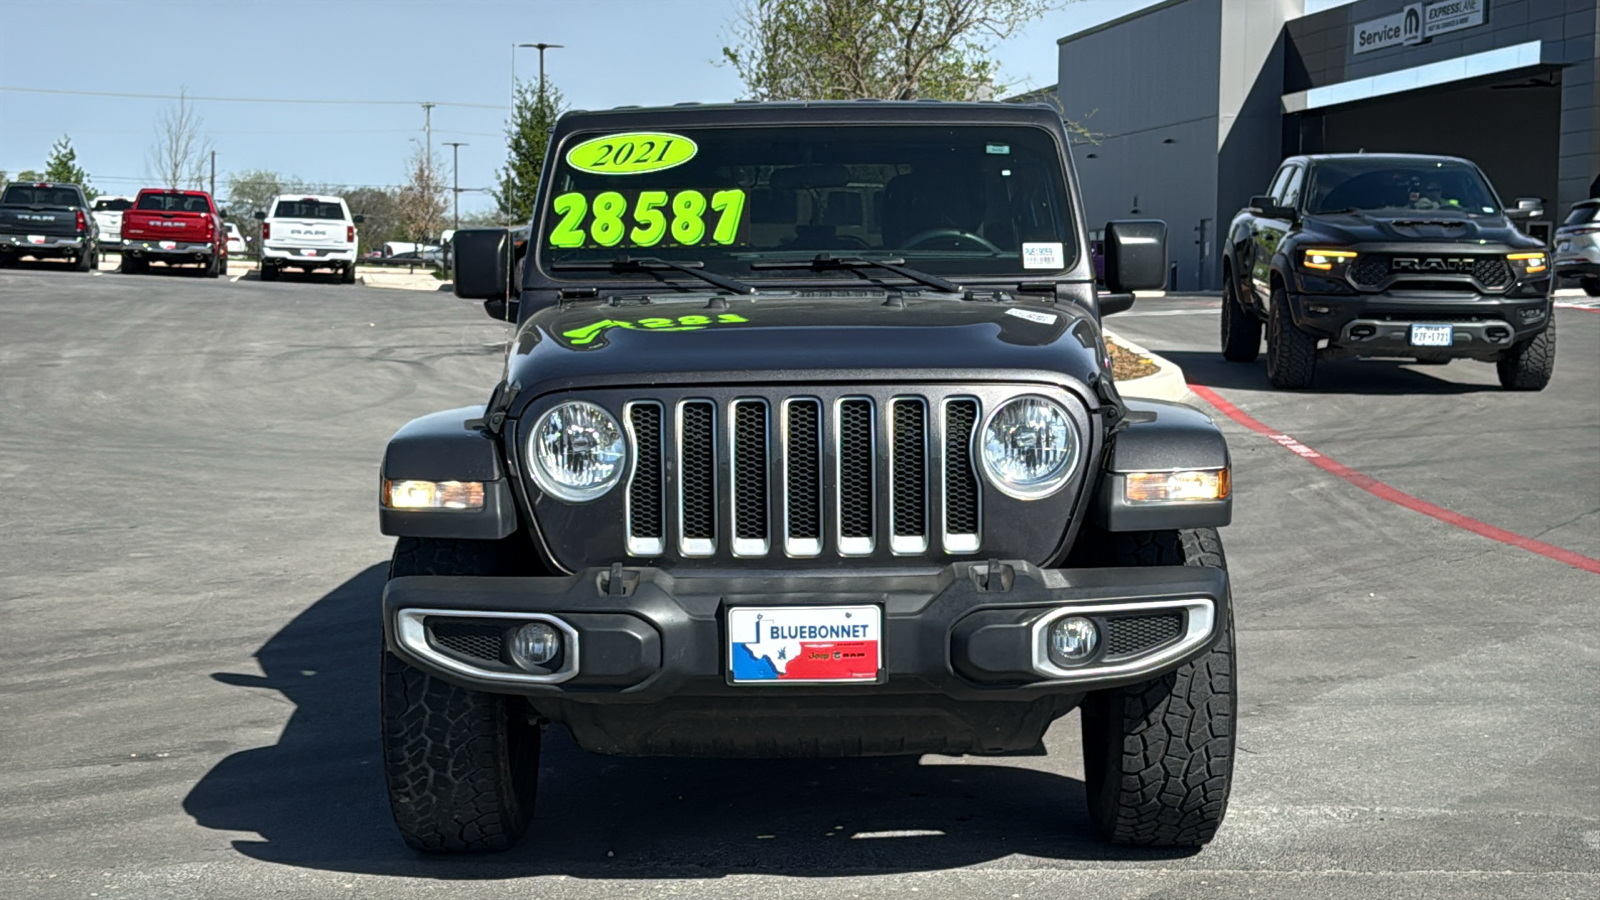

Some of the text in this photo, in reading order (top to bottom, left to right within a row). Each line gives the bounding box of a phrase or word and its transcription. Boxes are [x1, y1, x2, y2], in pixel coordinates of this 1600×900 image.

[1359, 25, 1401, 46] Service
[589, 139, 674, 167] 2021
[550, 189, 746, 248] 28587
[1392, 257, 1475, 271] RAM
[770, 624, 869, 640] BLUEBONNET
